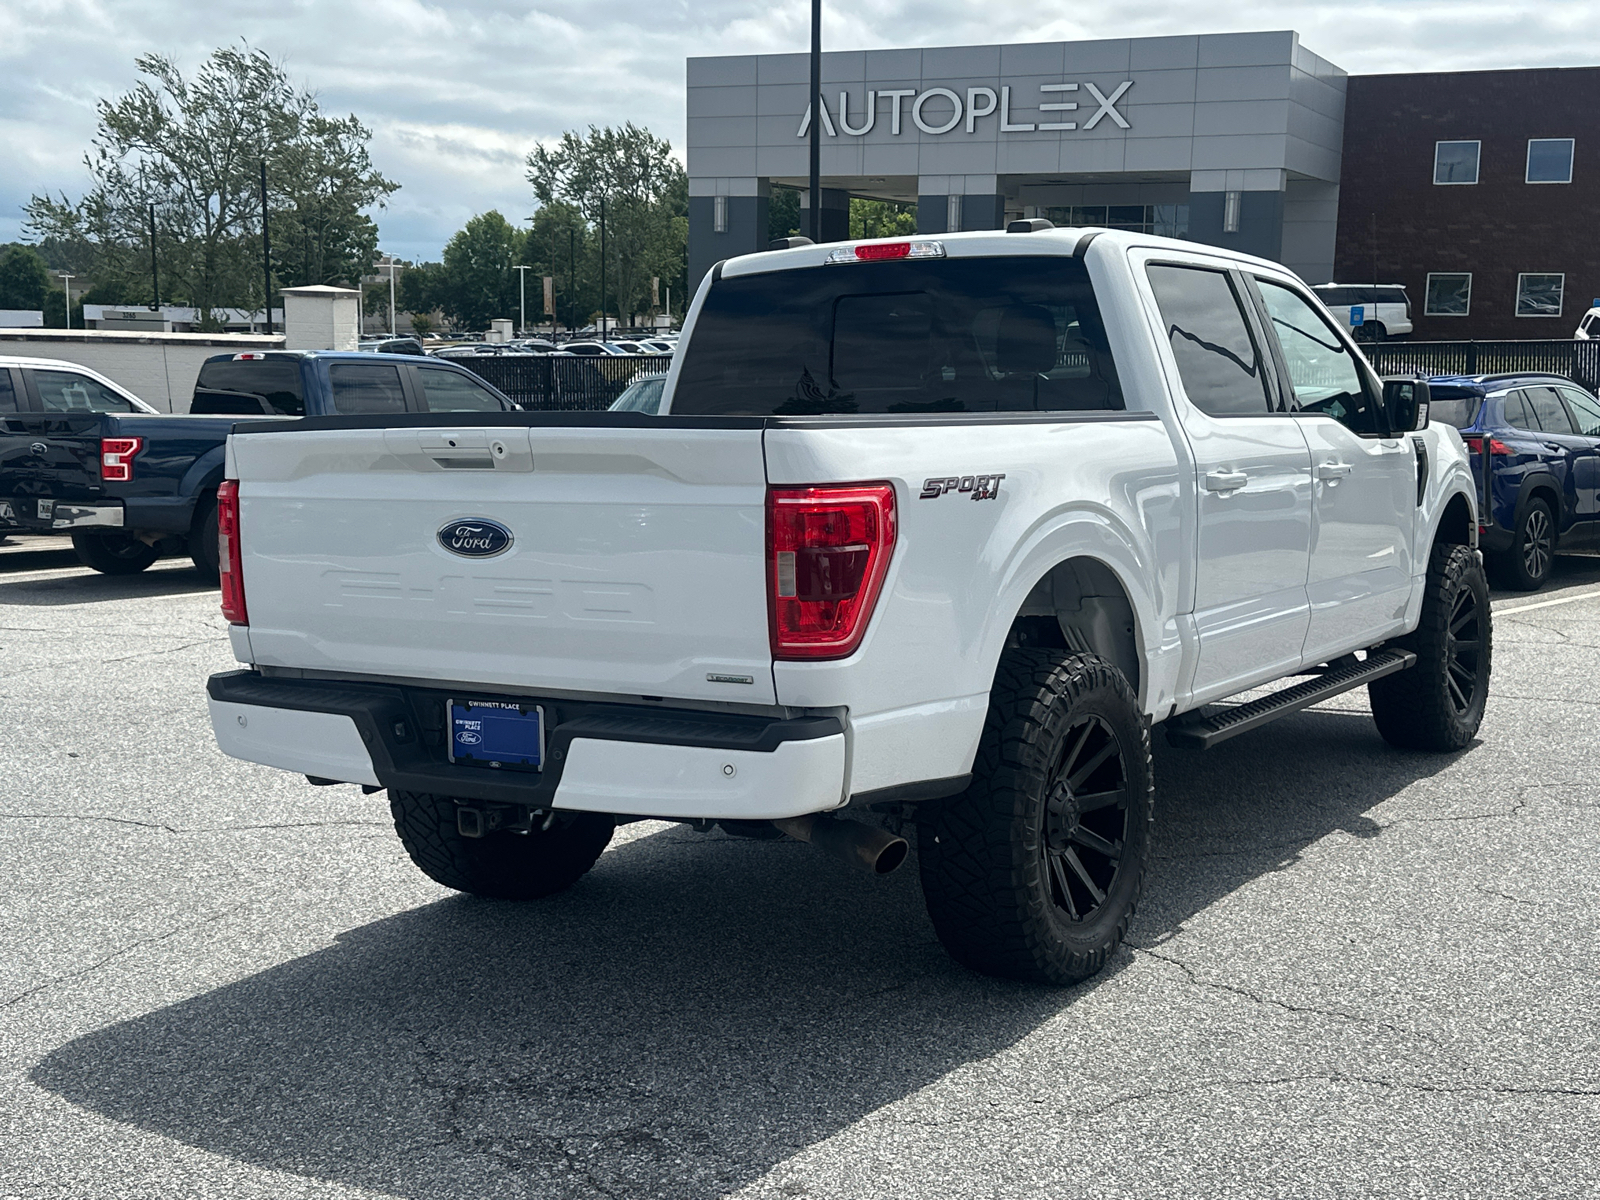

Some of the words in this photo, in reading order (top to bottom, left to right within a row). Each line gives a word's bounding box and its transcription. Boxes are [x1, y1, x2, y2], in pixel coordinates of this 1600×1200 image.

[797, 81, 1134, 137] AUTOPLEX
[919, 473, 1006, 499] SPORT
[452, 526, 493, 549] Ford
